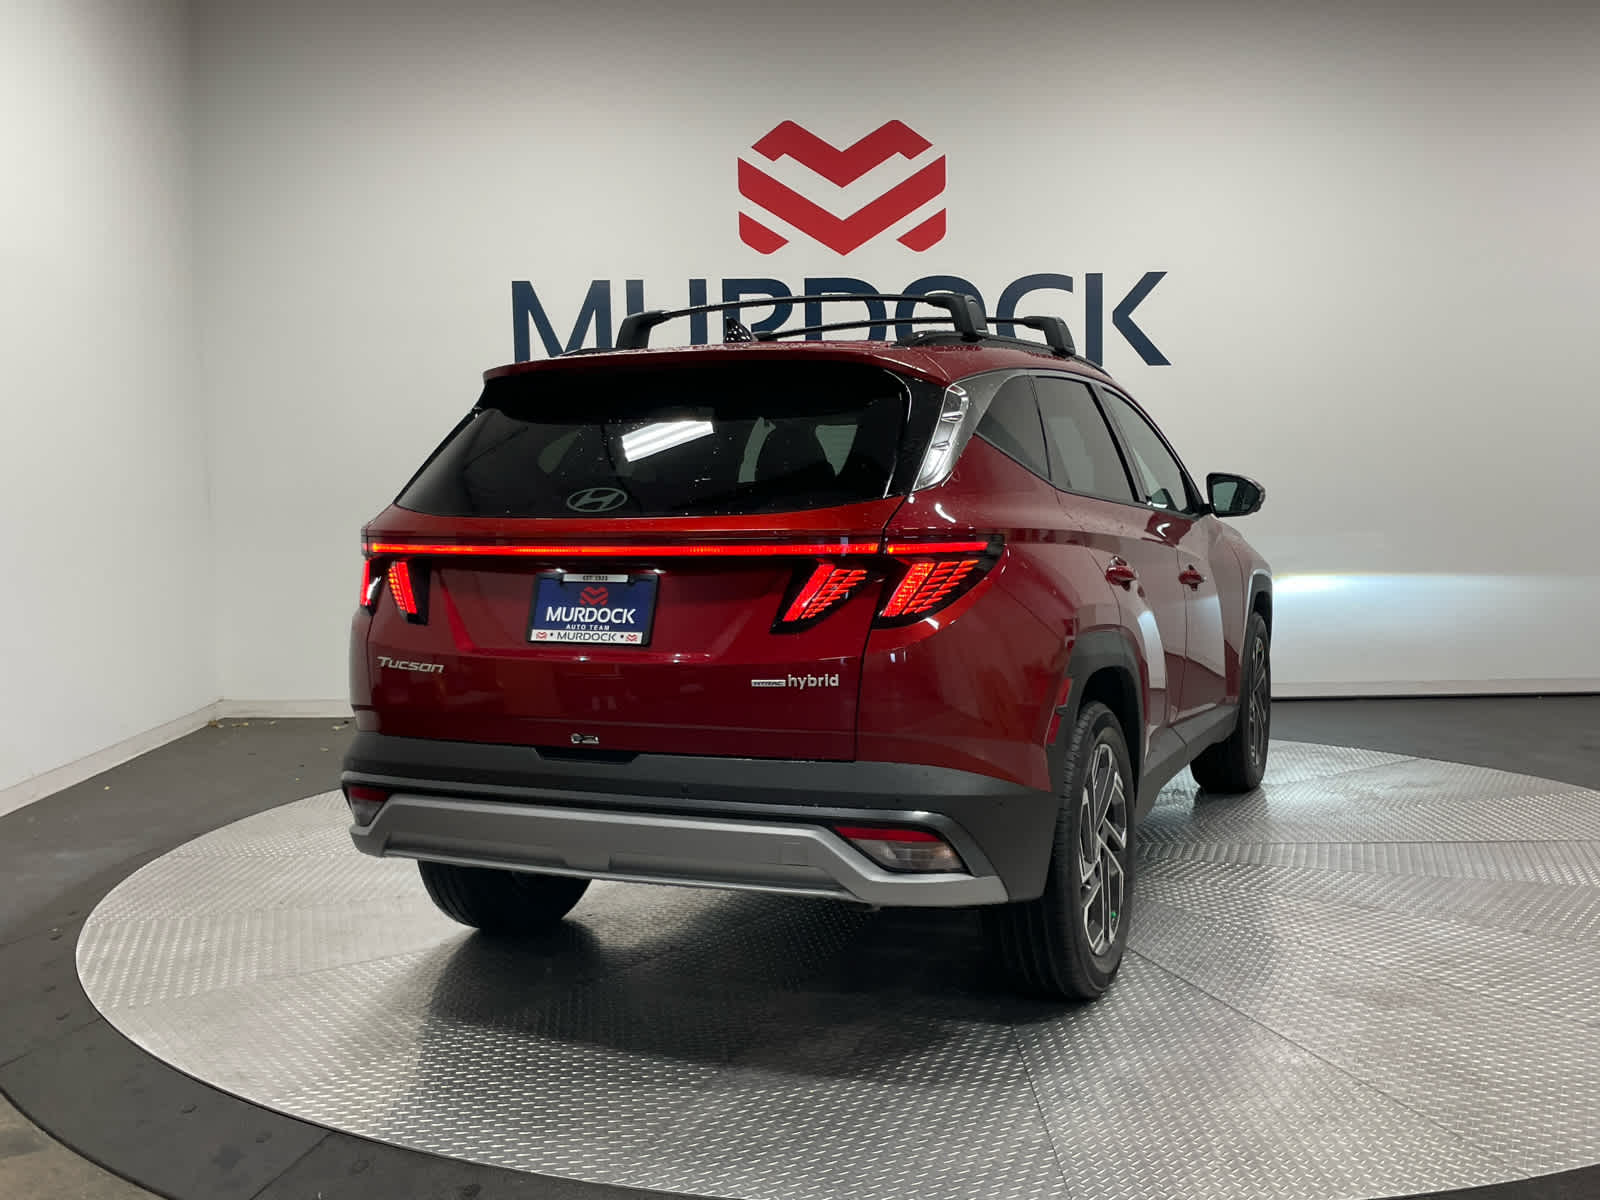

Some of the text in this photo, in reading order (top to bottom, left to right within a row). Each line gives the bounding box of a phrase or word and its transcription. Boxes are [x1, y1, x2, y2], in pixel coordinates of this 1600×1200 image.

[545, 606, 637, 624] MURDOCK
[556, 631, 617, 642] MURDOCK
[787, 673, 840, 690] hybrid
